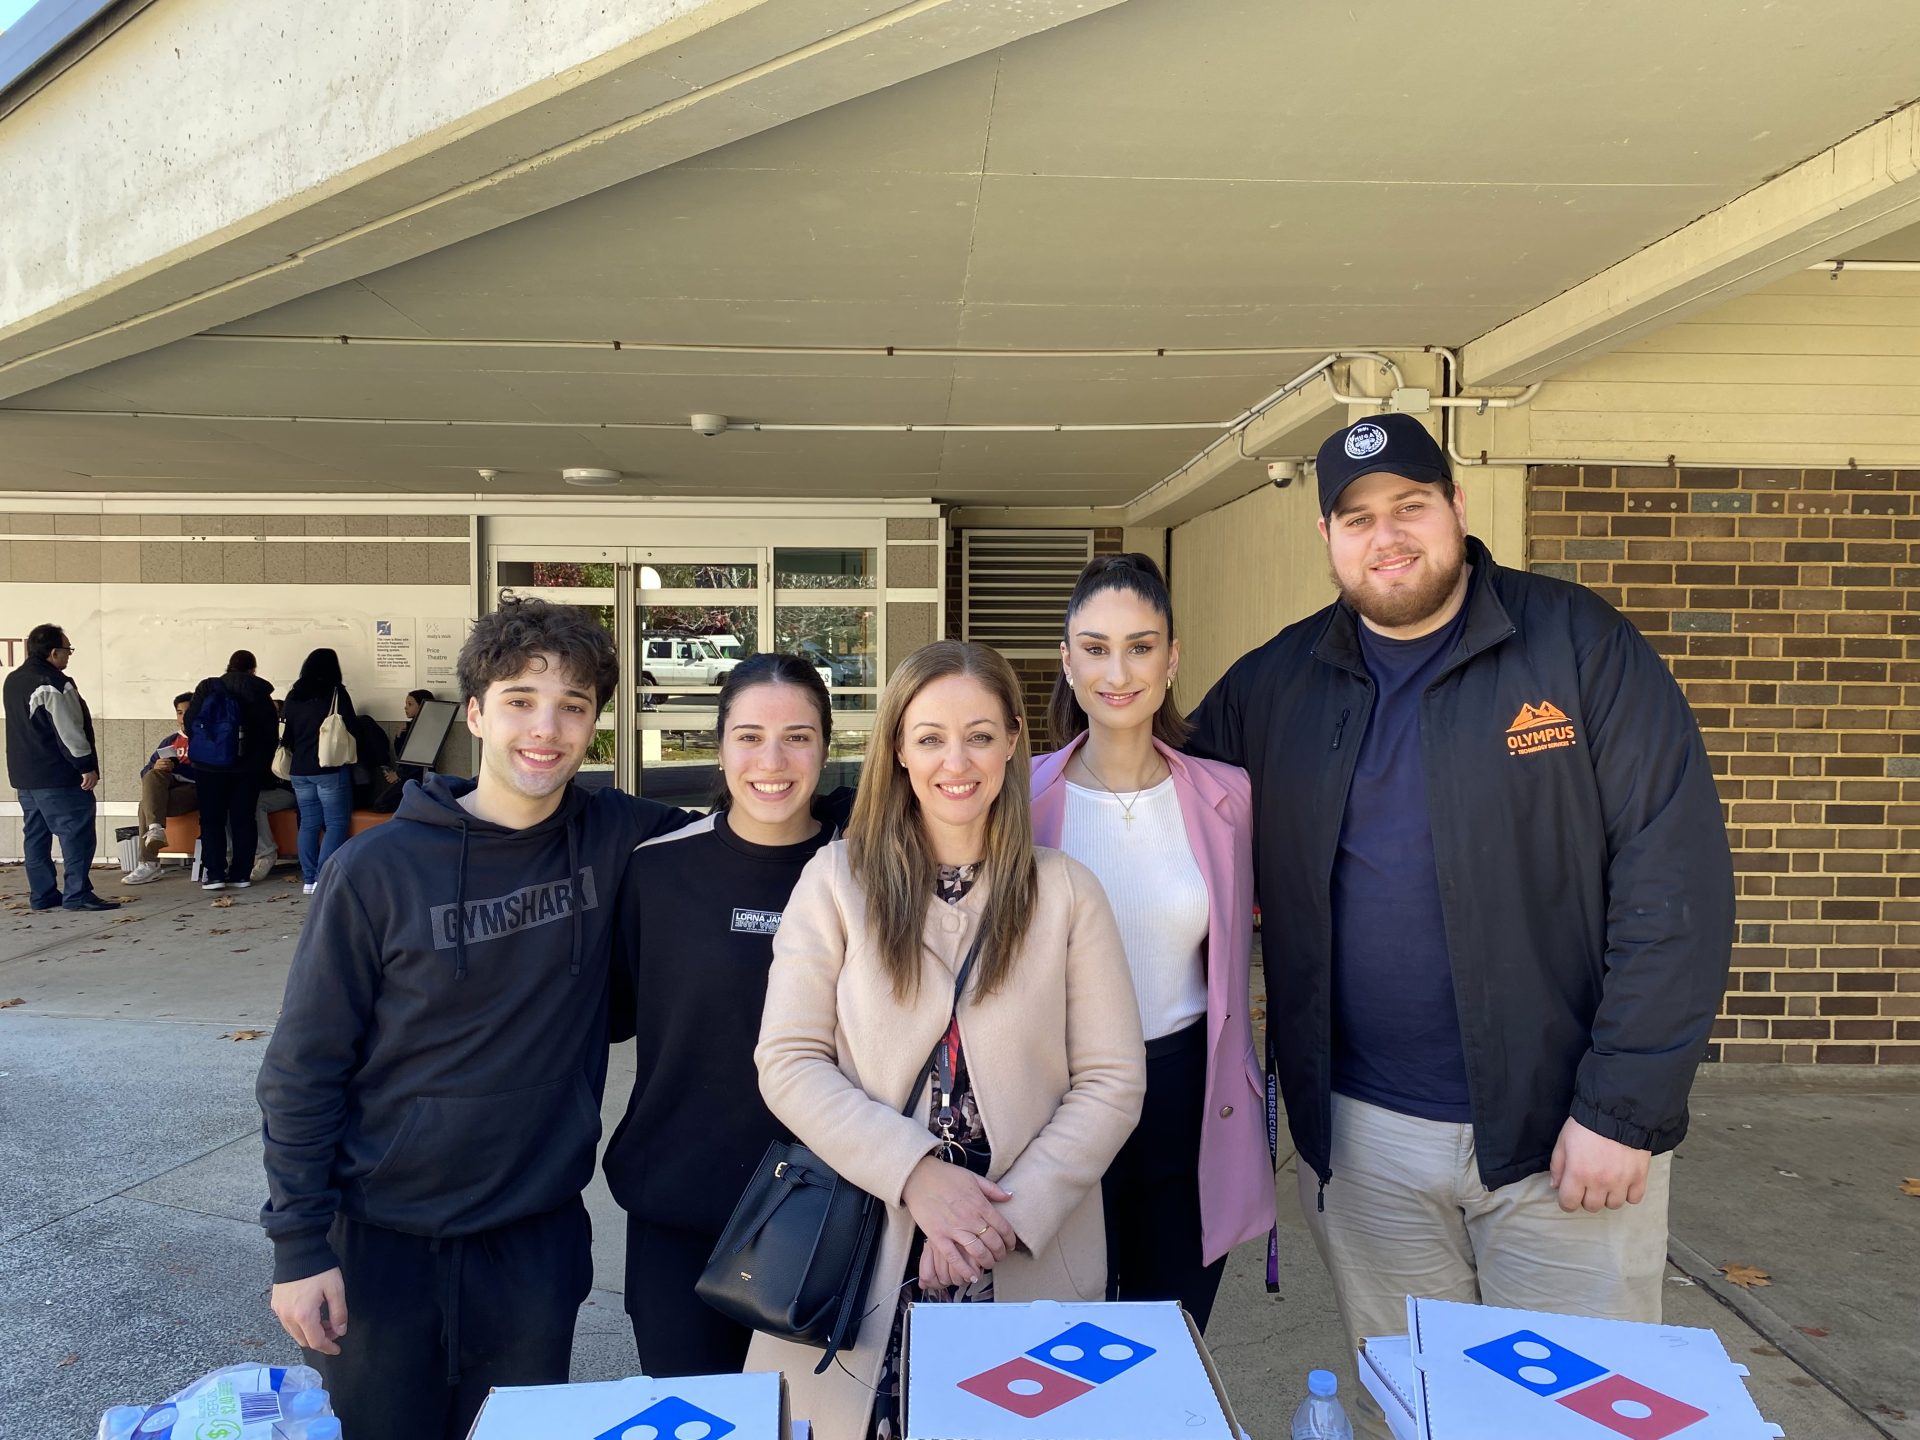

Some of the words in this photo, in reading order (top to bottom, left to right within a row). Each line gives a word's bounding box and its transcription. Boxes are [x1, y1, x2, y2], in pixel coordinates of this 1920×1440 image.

[1507, 726, 1575, 749] OLYMPUS
[735, 912, 765, 923] LORNA
[766, 915, 782, 924] JAN
[1267, 1073, 1277, 1158] CYBERSECURITY
